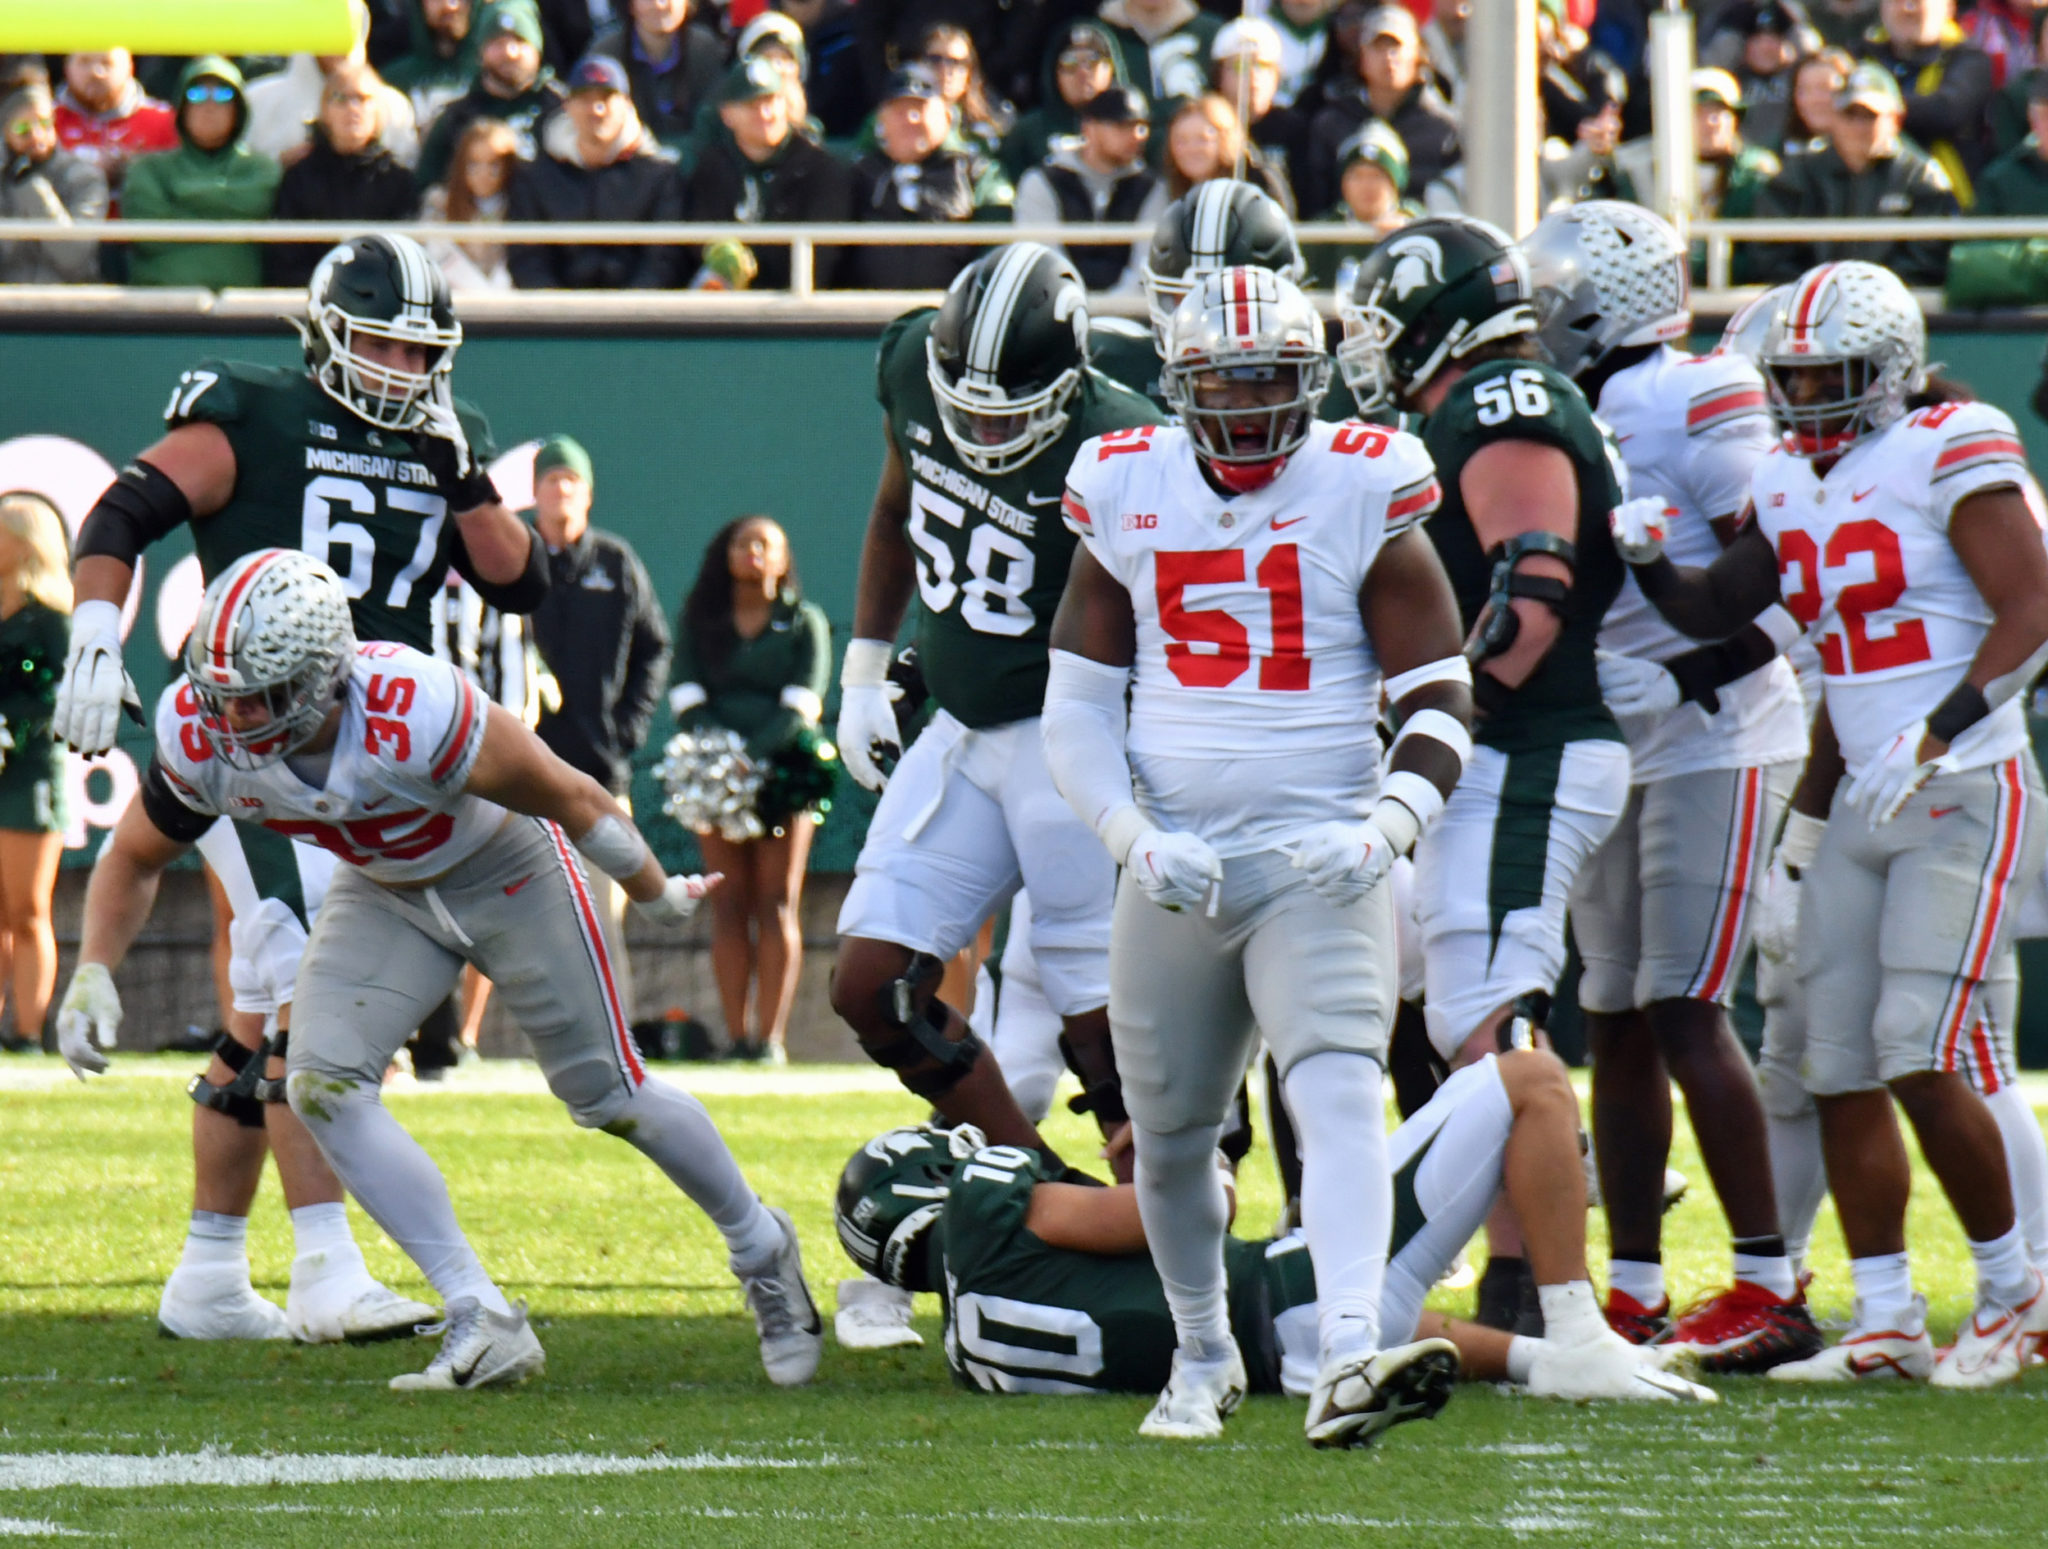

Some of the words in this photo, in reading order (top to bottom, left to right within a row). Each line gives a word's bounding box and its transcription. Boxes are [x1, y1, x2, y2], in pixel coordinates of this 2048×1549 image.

[1473, 368, 1550, 427] 56
[305, 446, 396, 480] MICHIGAN
[398, 460, 438, 487] STA
[910, 448, 989, 511] MICHIGAN
[987, 495, 1037, 537] STATE
[302, 475, 447, 608] 67
[908, 479, 1036, 637] 58
[1154, 542, 1311, 690] 51
[1777, 518, 1932, 676] 22
[365, 674, 417, 762] 35
[962, 1145, 1031, 1183] 10
